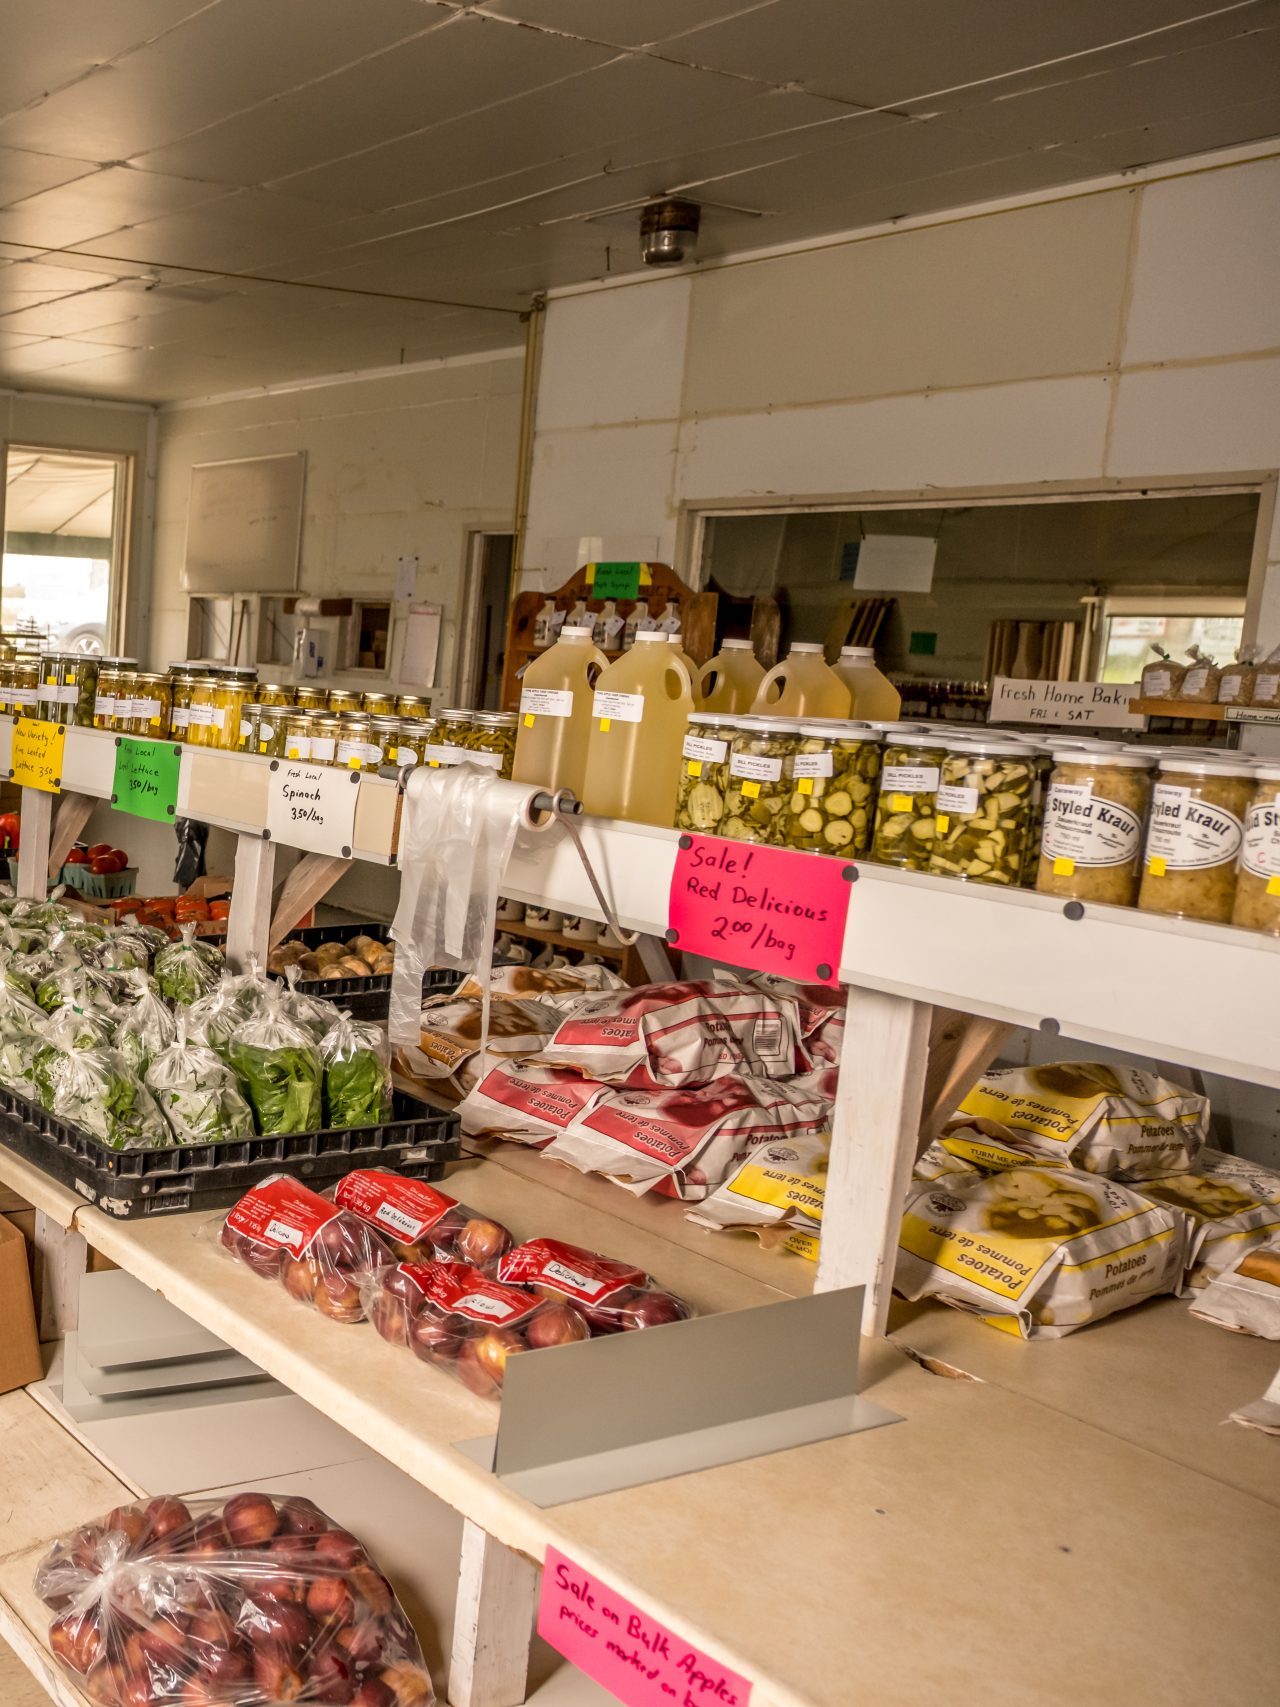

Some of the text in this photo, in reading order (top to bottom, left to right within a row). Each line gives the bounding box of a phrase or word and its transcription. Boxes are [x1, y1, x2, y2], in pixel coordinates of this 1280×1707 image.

[1001, 684, 1131, 705] Fresh Home Baki
[1030, 708, 1046, 718] FRI
[1068, 710, 1095, 721] SAT
[135, 746, 156, 757] Local
[288, 769, 323, 781] Fresh Local
[282, 784, 321, 801] Spinach
[1052, 798, 1135, 836] Styled Kraut
[1185, 806, 1231, 836] Kraut
[689, 846, 754, 879] Sale!
[687, 877, 828, 922] Red Delicious
[509, 1078, 529, 1090] terre
[528, 1098, 570, 1120] Potatoes
[542, 1090, 578, 1109] Pommes
[979, 1086, 1080, 1125] Pommes de terre
[616, 1111, 690, 1151] Pommes de terre
[1011, 1110, 1072, 1133] Potatoes
[1141, 1125, 1175, 1138] Potatoes
[634, 1131, 681, 1159] Potatoes
[970, 1148, 995, 1159] TURN
[996, 1155, 1009, 1163] ME
[763, 1170, 787, 1181] terre
[788, 1178, 801, 1186] de
[787, 1190, 825, 1210] tatoes
[928, 1225, 1032, 1276] Pommes de terre
[957, 1253, 1024, 1290] Potatoes
[1105, 1254, 1147, 1279] Potatoes
[1089, 1279, 1125, 1300] Pommes
[555, 1564, 738, 1706] Sale on Bulk Apples
[559, 1605, 677, 1697] prices marked on
